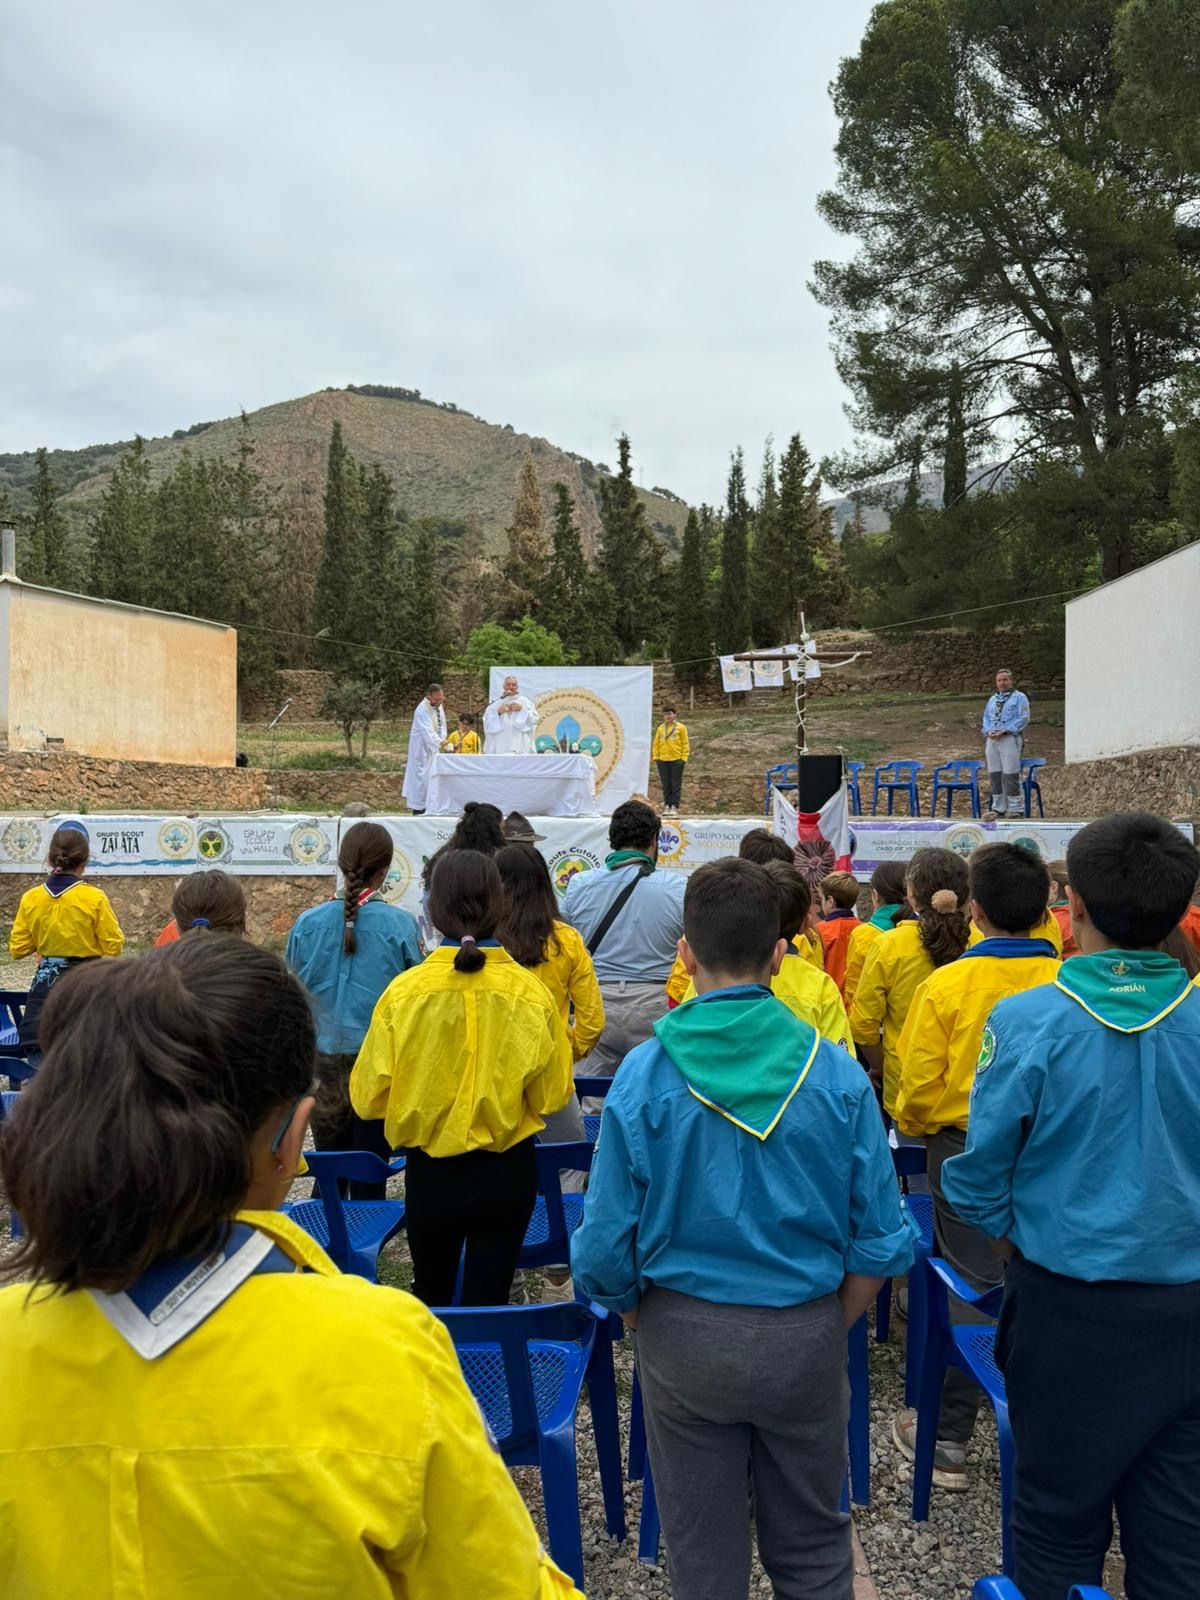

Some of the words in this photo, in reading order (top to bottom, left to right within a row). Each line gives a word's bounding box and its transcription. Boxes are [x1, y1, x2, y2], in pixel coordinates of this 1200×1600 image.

[121, 830, 144, 838] SCOUT
[243, 829, 276, 840] GRUPO
[694, 831, 722, 840] GRUPO
[723, 832, 745, 841] SCOU
[1108, 982, 1146, 993] ADRIÁN
